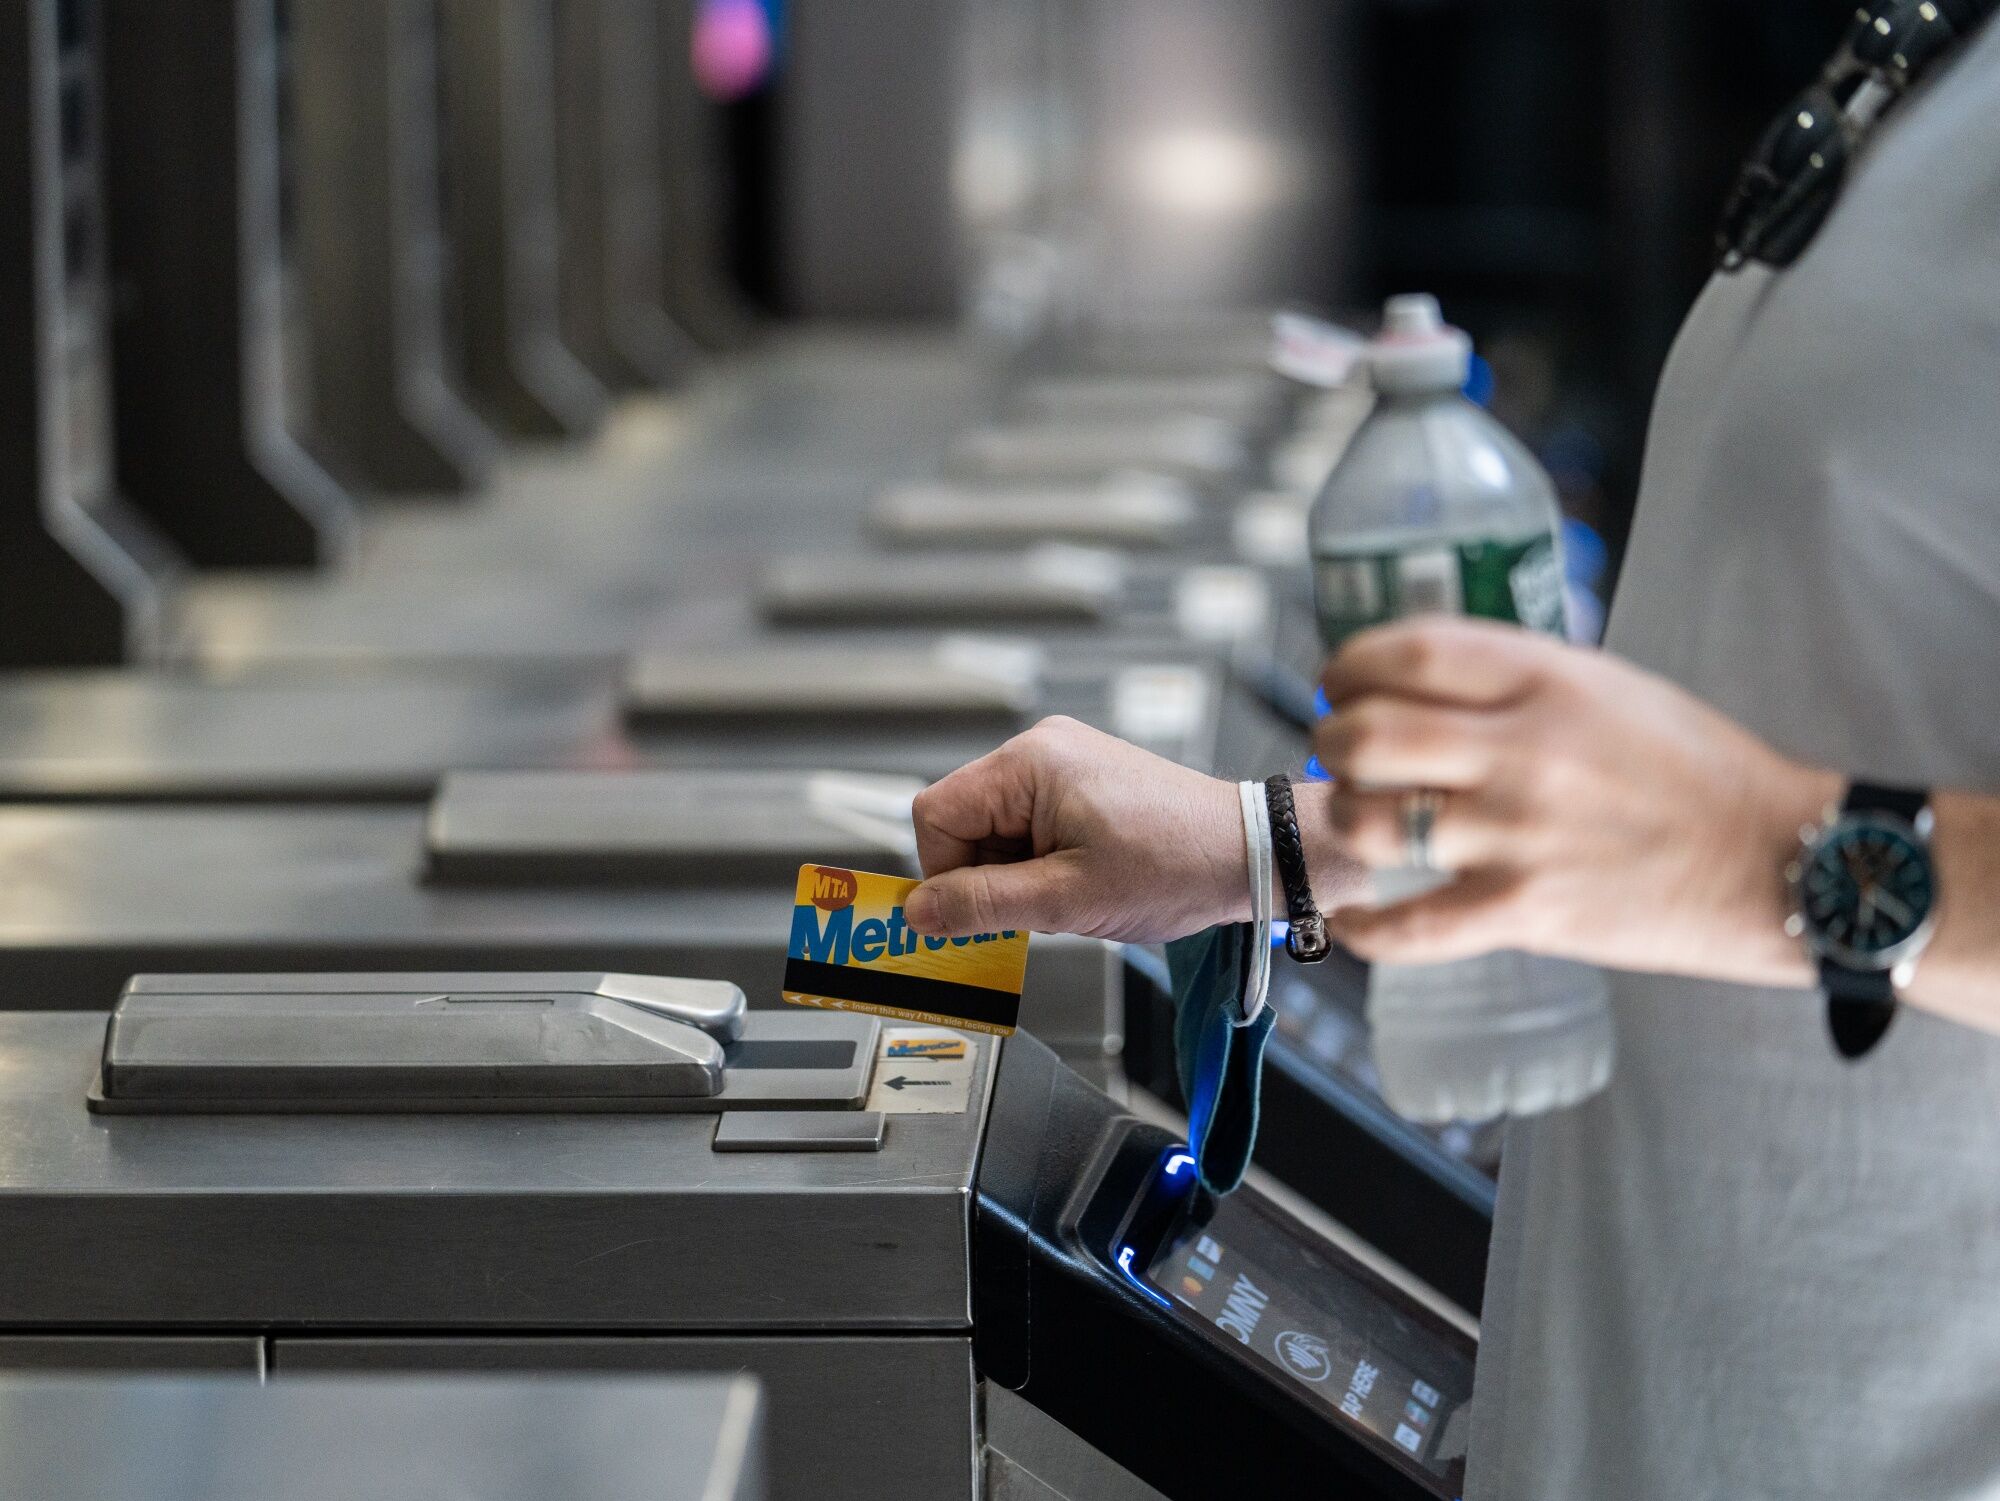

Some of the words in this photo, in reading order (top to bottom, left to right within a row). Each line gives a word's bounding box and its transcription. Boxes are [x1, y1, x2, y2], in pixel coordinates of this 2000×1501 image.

[812, 872, 849, 899] MTA
[787, 904, 1016, 966] Metro
[852, 1002, 878, 1013] Insert
[879, 1006, 896, 1016] this
[898, 1010, 915, 1020] way
[923, 1013, 942, 1024] This
[944, 1017, 962, 1027] side
[965, 1020, 992, 1033] facing
[993, 1027, 1010, 1036] you
[1340, 1391, 1364, 1420] AP
